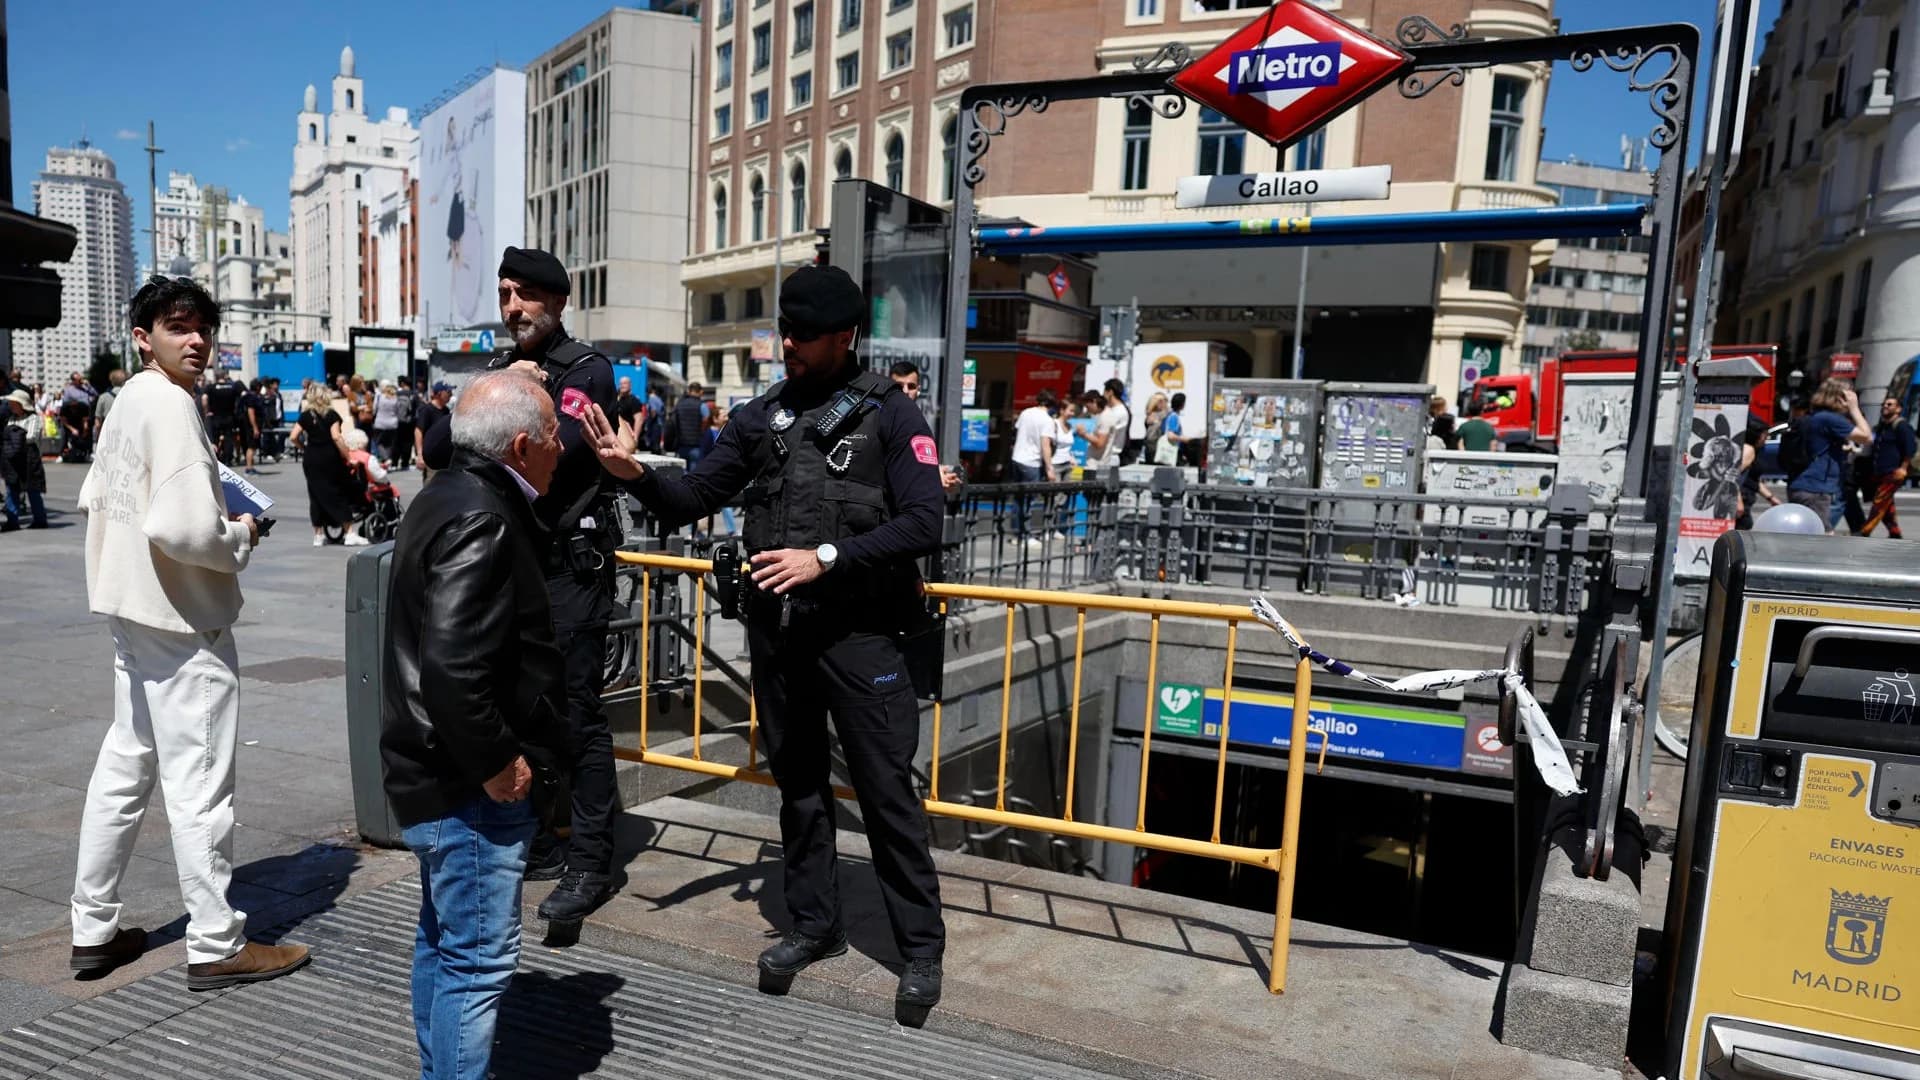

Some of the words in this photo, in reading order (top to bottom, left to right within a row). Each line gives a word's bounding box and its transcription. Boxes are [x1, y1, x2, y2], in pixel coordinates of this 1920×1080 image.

[1238, 52, 1332, 84] Metro
[1238, 177, 1319, 198] Callao
[1767, 605, 1819, 616] MADRID
[1807, 776, 1822, 784] USE
[1826, 770, 1851, 780] FAVOR
[1806, 783, 1844, 793] CENICERO
[1830, 837, 1905, 859] ENVASES
[1809, 851, 1878, 869] PACKAGING
[1881, 861, 1920, 876] WASTE
[1792, 968, 1902, 1002] MADRID
